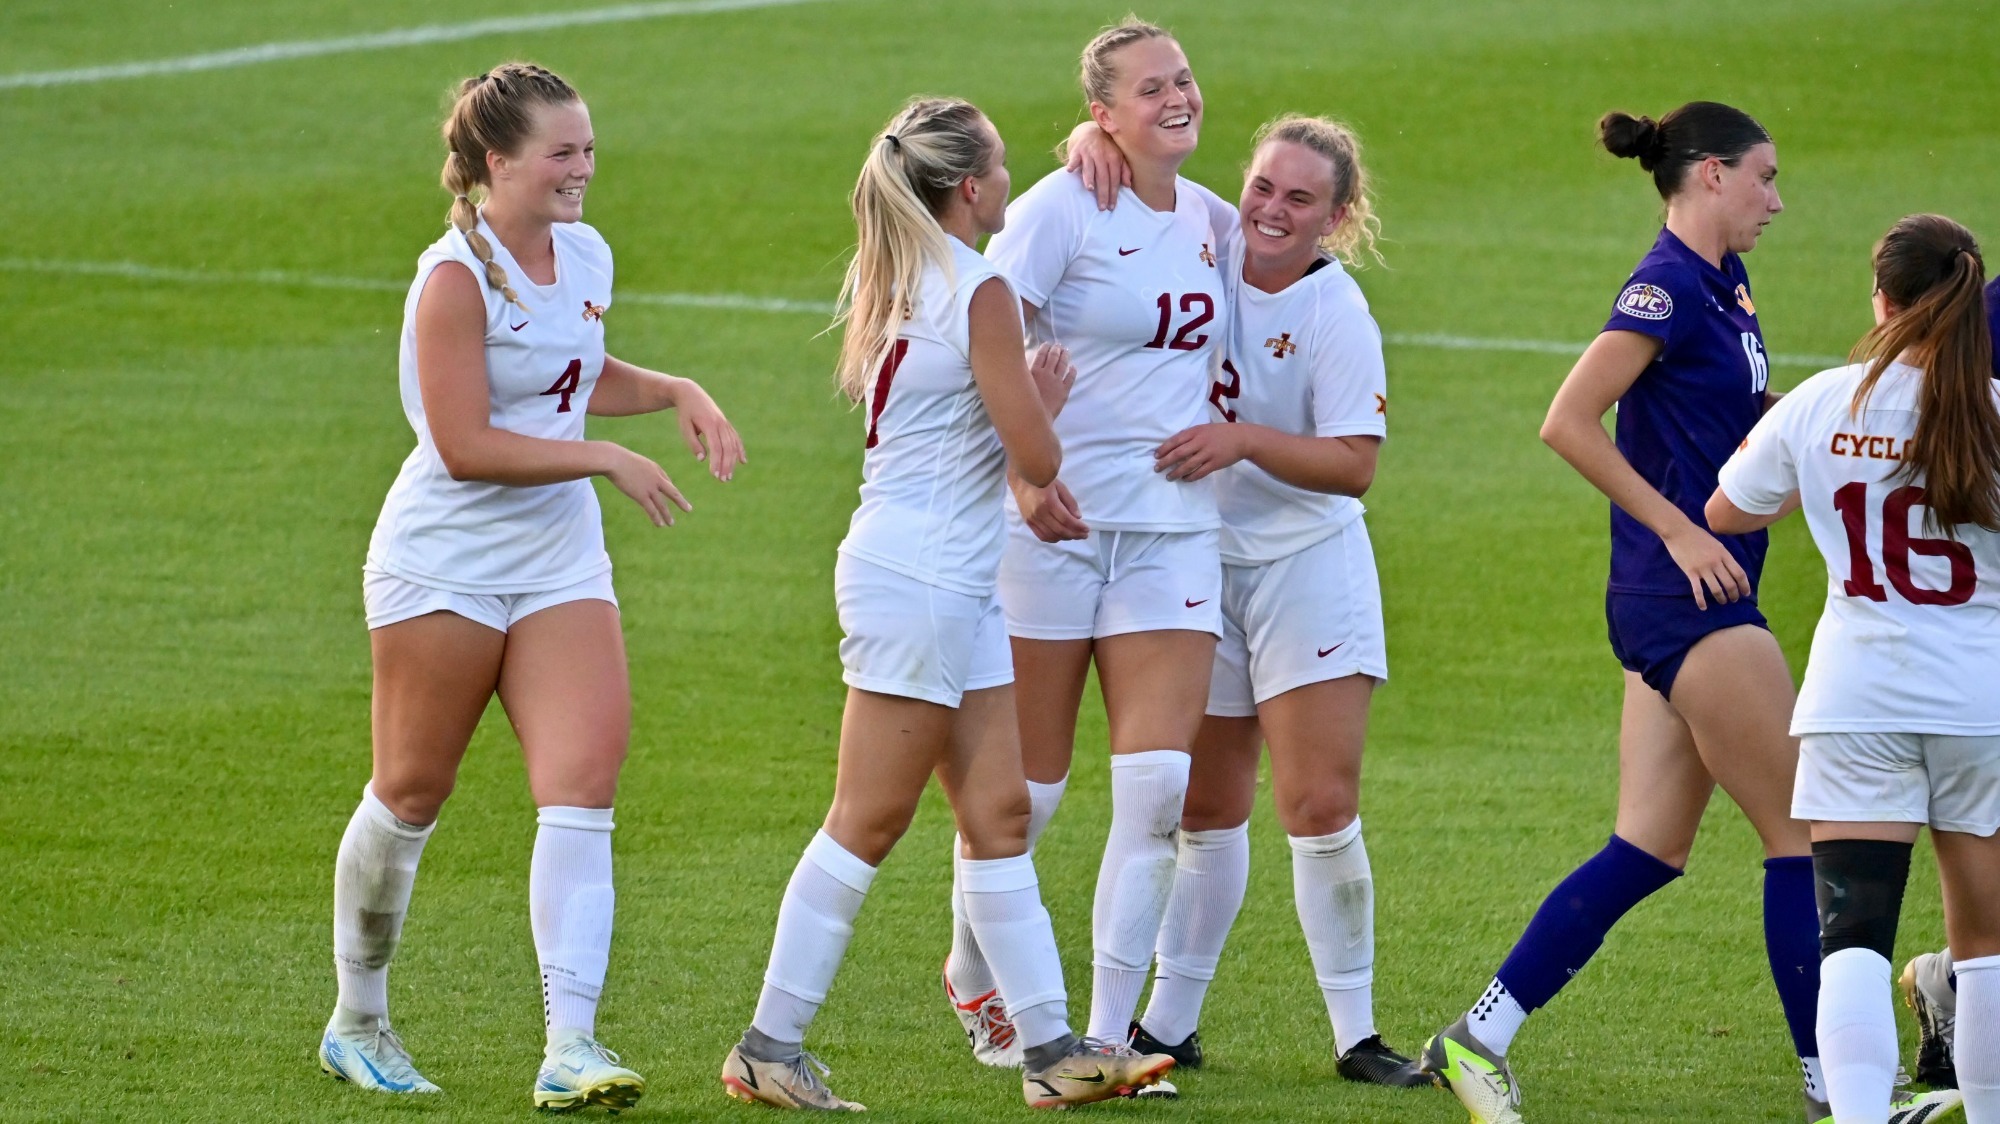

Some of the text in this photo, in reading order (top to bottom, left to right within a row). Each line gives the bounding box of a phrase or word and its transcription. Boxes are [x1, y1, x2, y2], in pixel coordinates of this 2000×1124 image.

[1143, 292, 1214, 351] 12
[1625, 293, 1662, 312] OVC
[539, 358, 582, 413] 4
[1741, 331, 1768, 394] 16
[1833, 481, 1977, 606] 16
